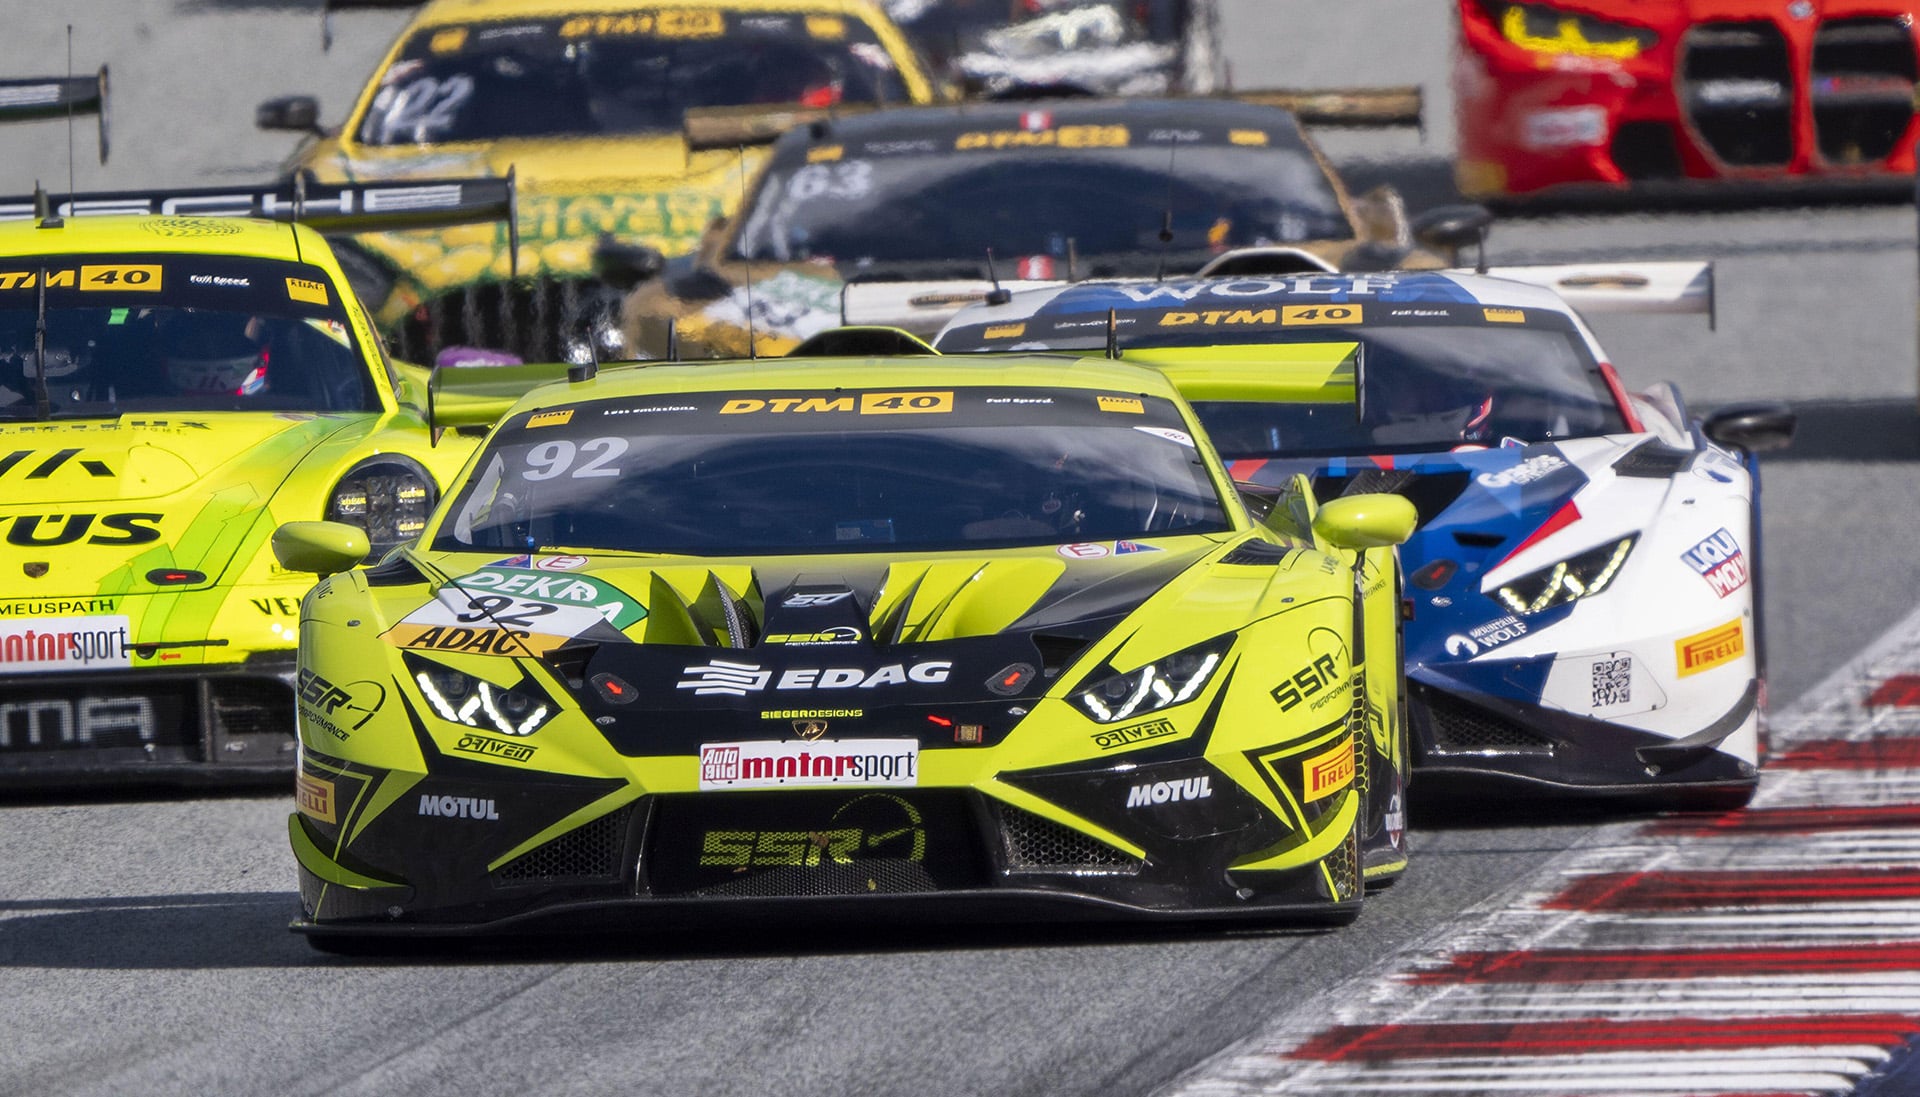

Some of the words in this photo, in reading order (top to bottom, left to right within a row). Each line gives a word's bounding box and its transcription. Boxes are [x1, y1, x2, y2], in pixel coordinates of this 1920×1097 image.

[90, 270, 151, 284] 40
[1112, 275, 1399, 301] WOLF
[1158, 308, 1277, 327] DTM
[1291, 307, 1352, 320] 40
[719, 397, 855, 415] DTM
[872, 396, 942, 409] 40
[521, 436, 630, 481] 92
[0, 513, 165, 546] ÜS
[0, 599, 115, 615] MEUSPATH
[457, 571, 624, 623] DEKRA
[458, 595, 558, 627] 92
[0, 626, 128, 664] otorsport
[407, 626, 531, 655] ADAC
[1478, 622, 1528, 648] WOLF
[776, 661, 952, 690] EDAG
[1270, 652, 1339, 713] SSR
[703, 748, 738, 764] Auto
[1126, 776, 1212, 808] MOTUL
[418, 794, 499, 821] MOTUL
[699, 828, 864, 867] SSR
